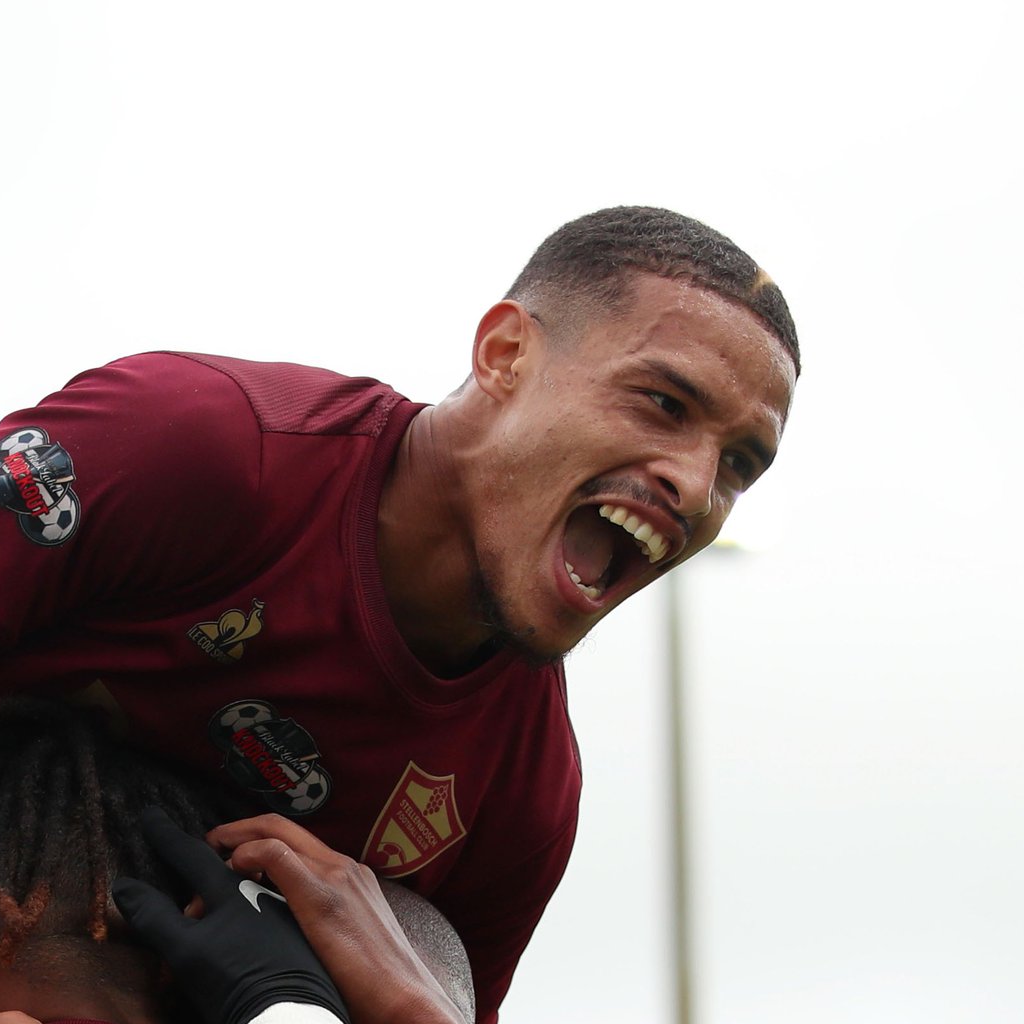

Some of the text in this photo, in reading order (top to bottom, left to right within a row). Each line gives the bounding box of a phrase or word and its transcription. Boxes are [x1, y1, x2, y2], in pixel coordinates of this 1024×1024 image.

[4, 452, 49, 516] KNOCKOUT
[232, 728, 296, 793] KNOCKOUT
[396, 810, 417, 838] FOOTBALL
[400, 799, 438, 846] STELLENBOSCH
